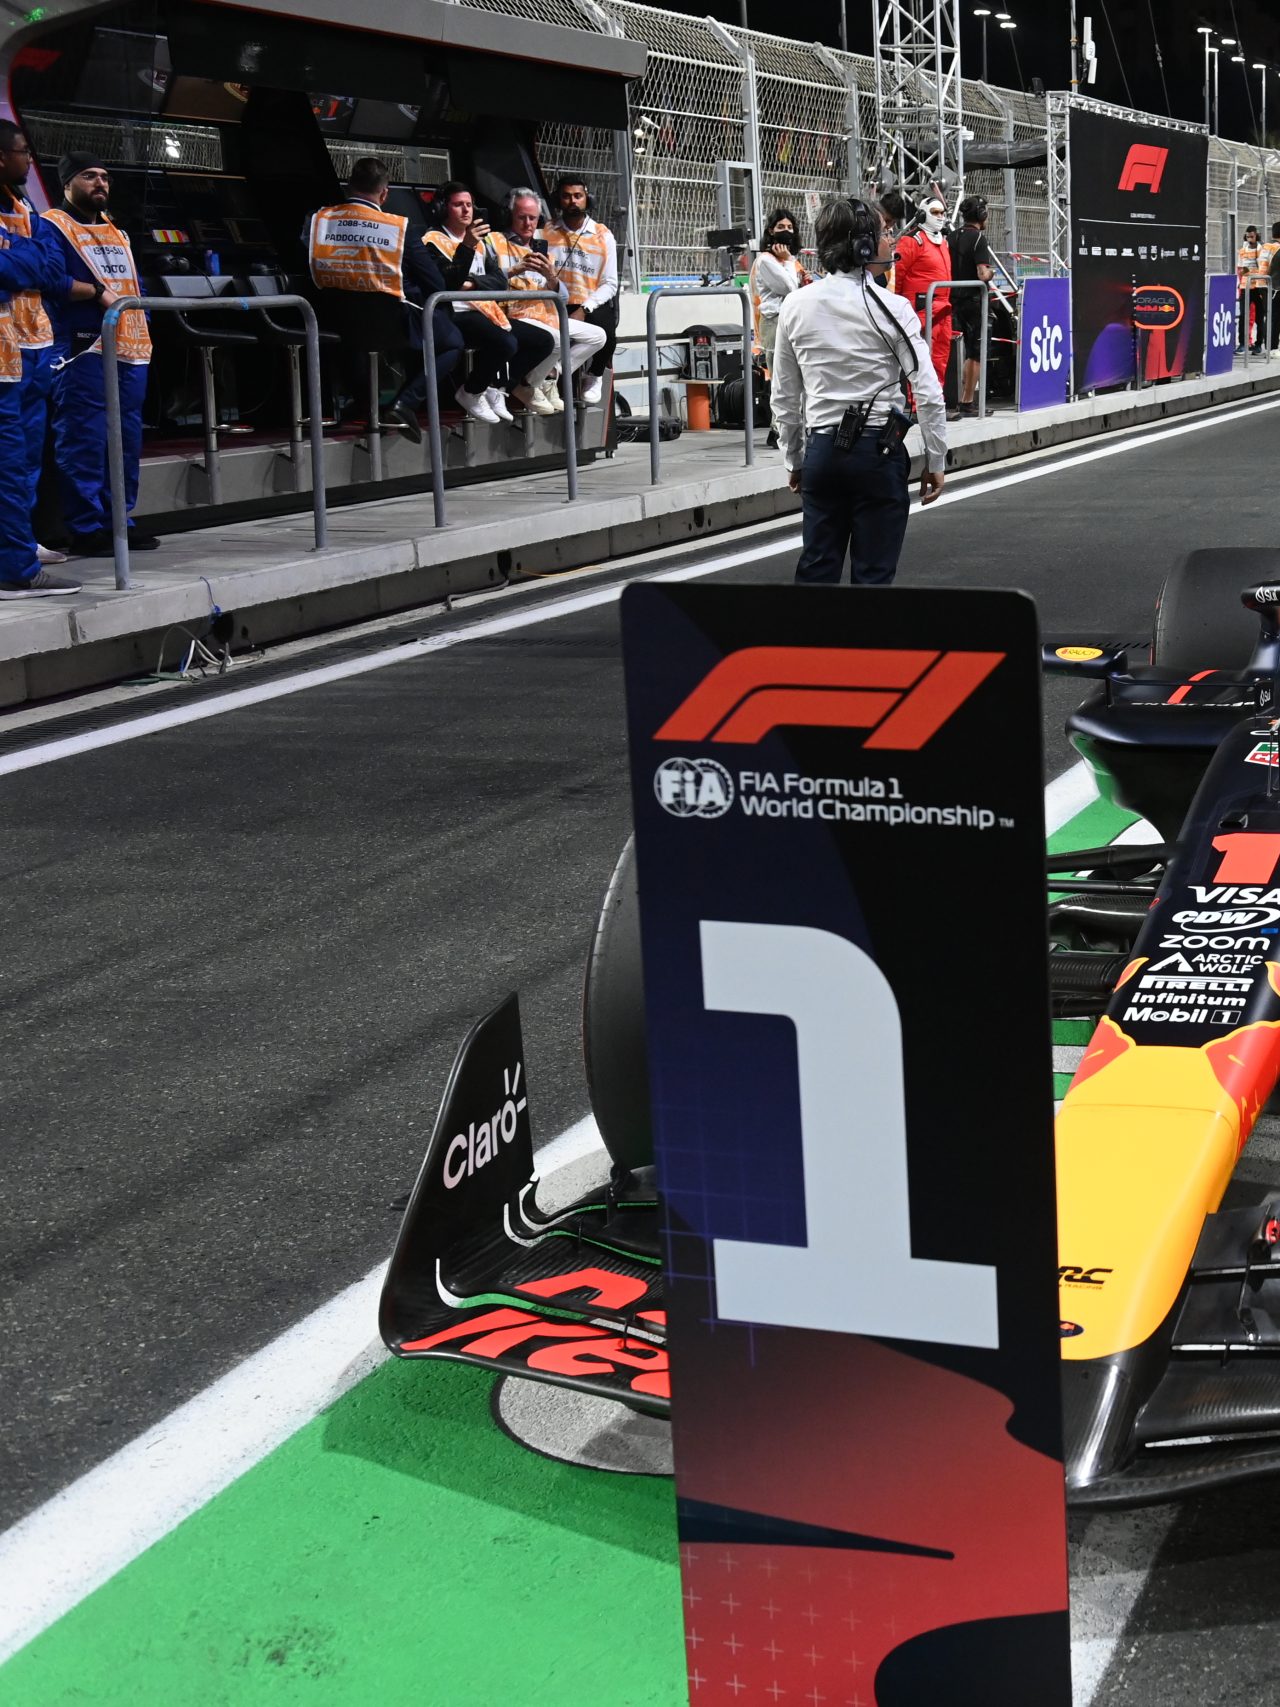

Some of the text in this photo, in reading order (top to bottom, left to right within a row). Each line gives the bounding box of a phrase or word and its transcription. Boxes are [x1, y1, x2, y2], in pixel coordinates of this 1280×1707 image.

[325, 234, 390, 246] PADDOCK CLUB
[1212, 304, 1232, 347] stc
[1030, 315, 1063, 373] stc
[1264, 588, 1278, 601] Sui
[652, 645, 1008, 750] F1
[739, 771, 904, 799] FIA Formula 1
[740, 795, 813, 819] World
[818, 799, 995, 830] Championship
[1191, 953, 1264, 965] ARCTIC
[1199, 963, 1254, 974] WOLF
[1138, 975, 1255, 992] PIRELLI
[1131, 992, 1247, 1007] infinitum
[1122, 1007, 1209, 1023] Mobil
[443, 1100, 517, 1190] Claro
[699, 919, 999, 1349] 1
